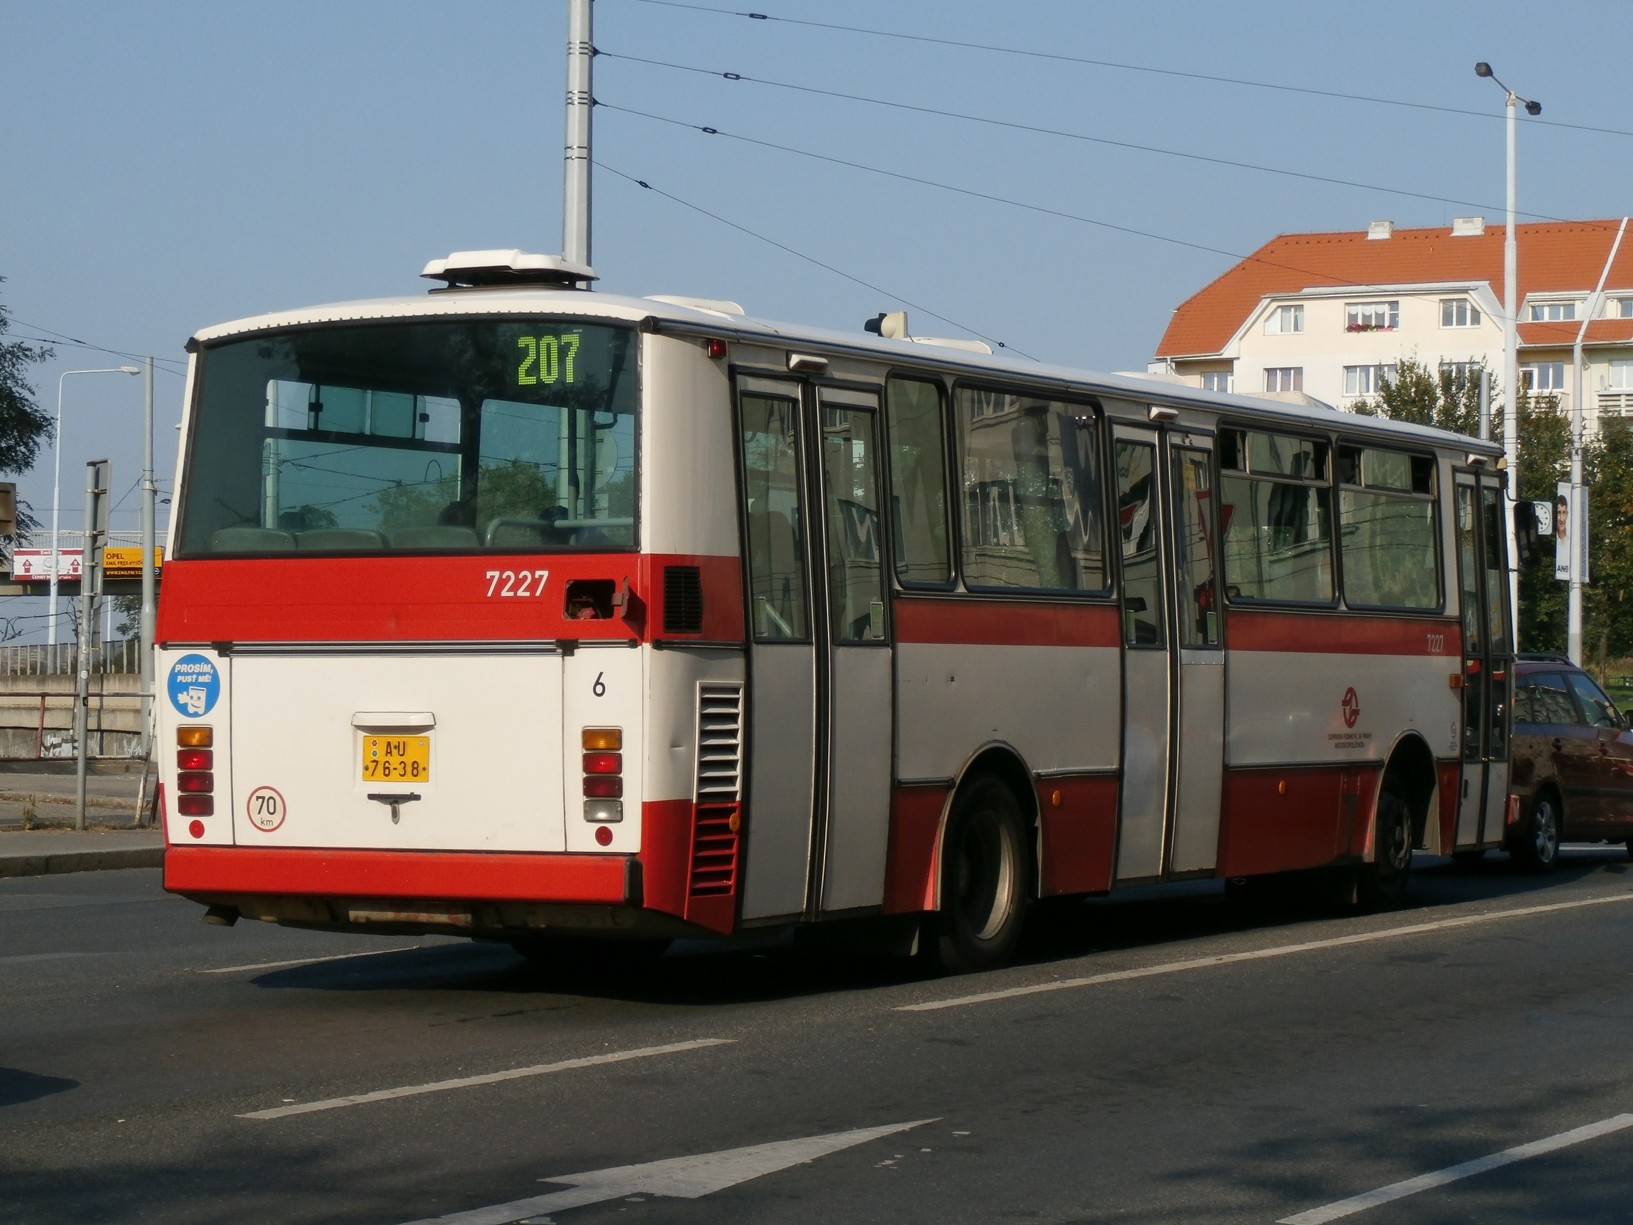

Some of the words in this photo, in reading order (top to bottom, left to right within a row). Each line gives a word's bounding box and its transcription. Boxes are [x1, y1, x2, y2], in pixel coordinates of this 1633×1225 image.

[518, 334, 579, 385] 207
[485, 570, 549, 597] 7227
[1426, 633, 1444, 652] 7227
[175, 662, 213, 675] PROSÍM,
[592, 671, 606, 698] 6
[370, 759, 419, 777] 76-38
[255, 795, 277, 816] 70
[260, 817, 274, 826] km
